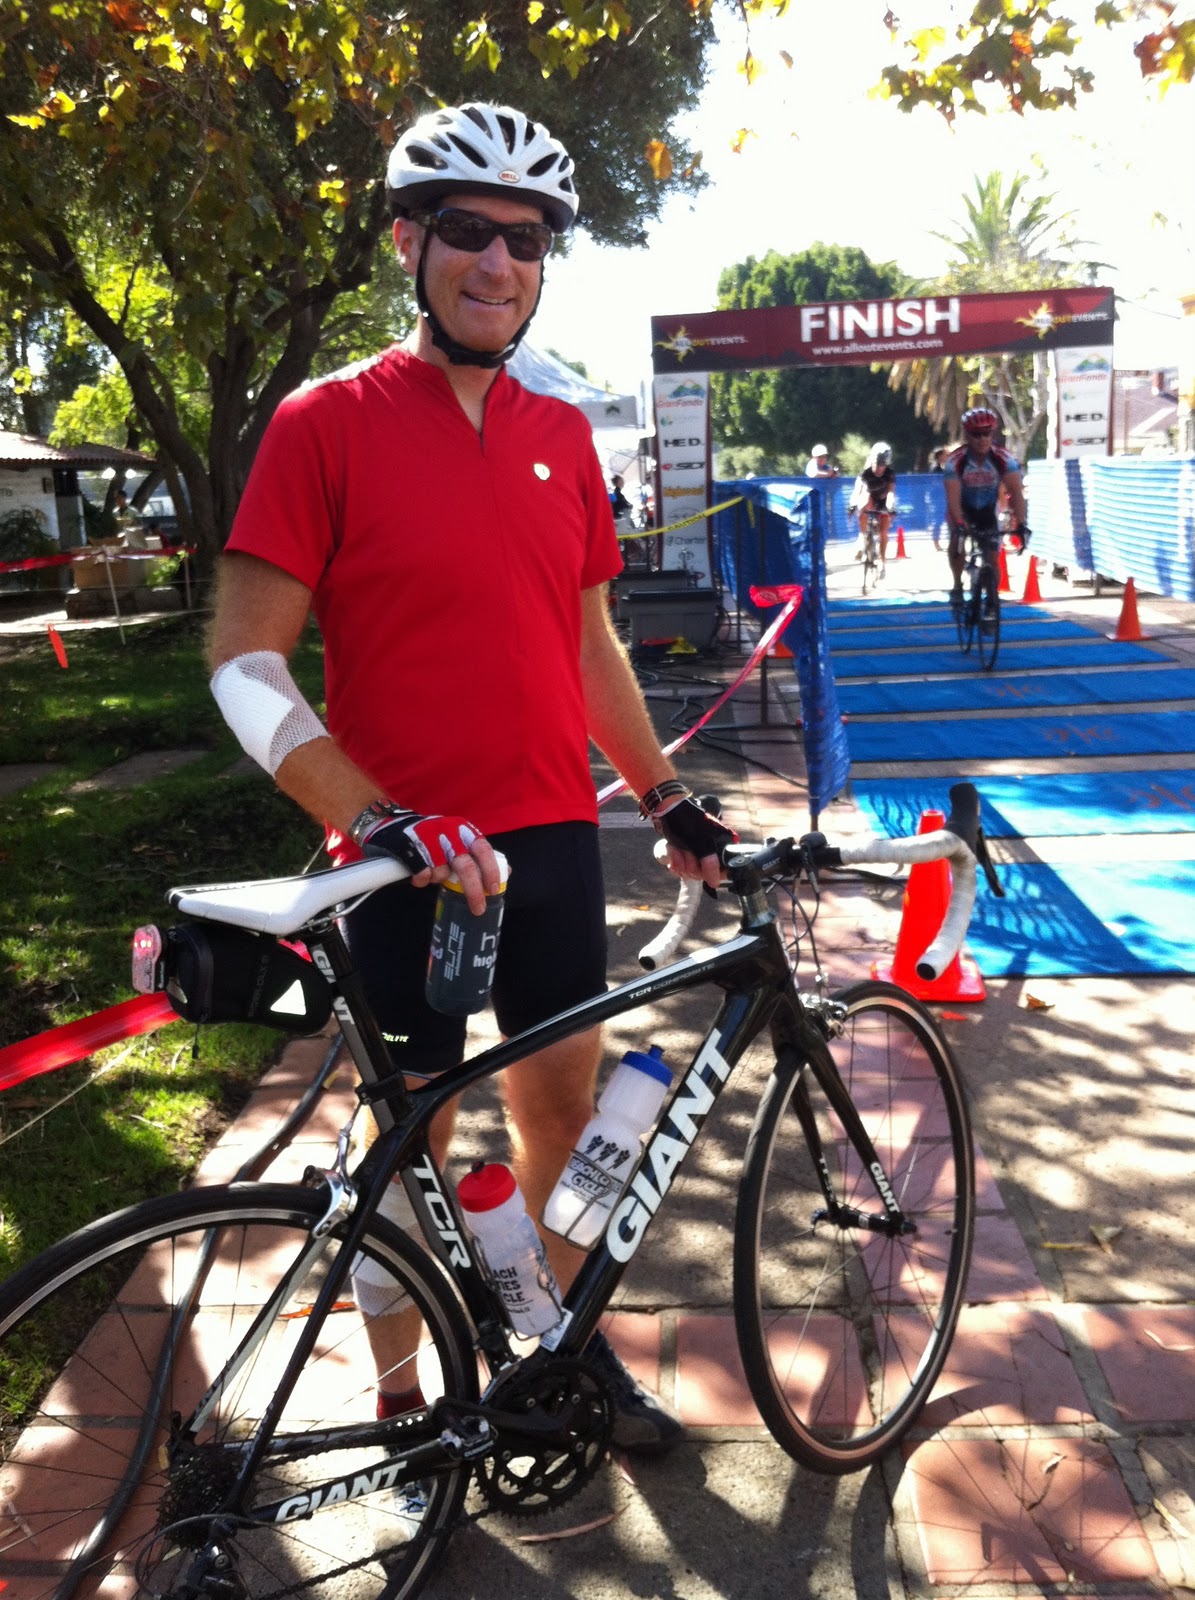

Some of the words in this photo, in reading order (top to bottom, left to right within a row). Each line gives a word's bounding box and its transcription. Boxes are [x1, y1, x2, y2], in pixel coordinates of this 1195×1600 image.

[800, 298, 960, 342] FINISH
[811, 338, 944, 356] www.alloutevents.com
[627, 987, 652, 999] TCR
[652, 963, 716, 990] COMPOSITE
[606, 1028, 731, 1263] GIANT
[412, 1153, 471, 1269] TCR
[870, 1162, 900, 1212] GIANT
[275, 1461, 408, 1523] GIANT
